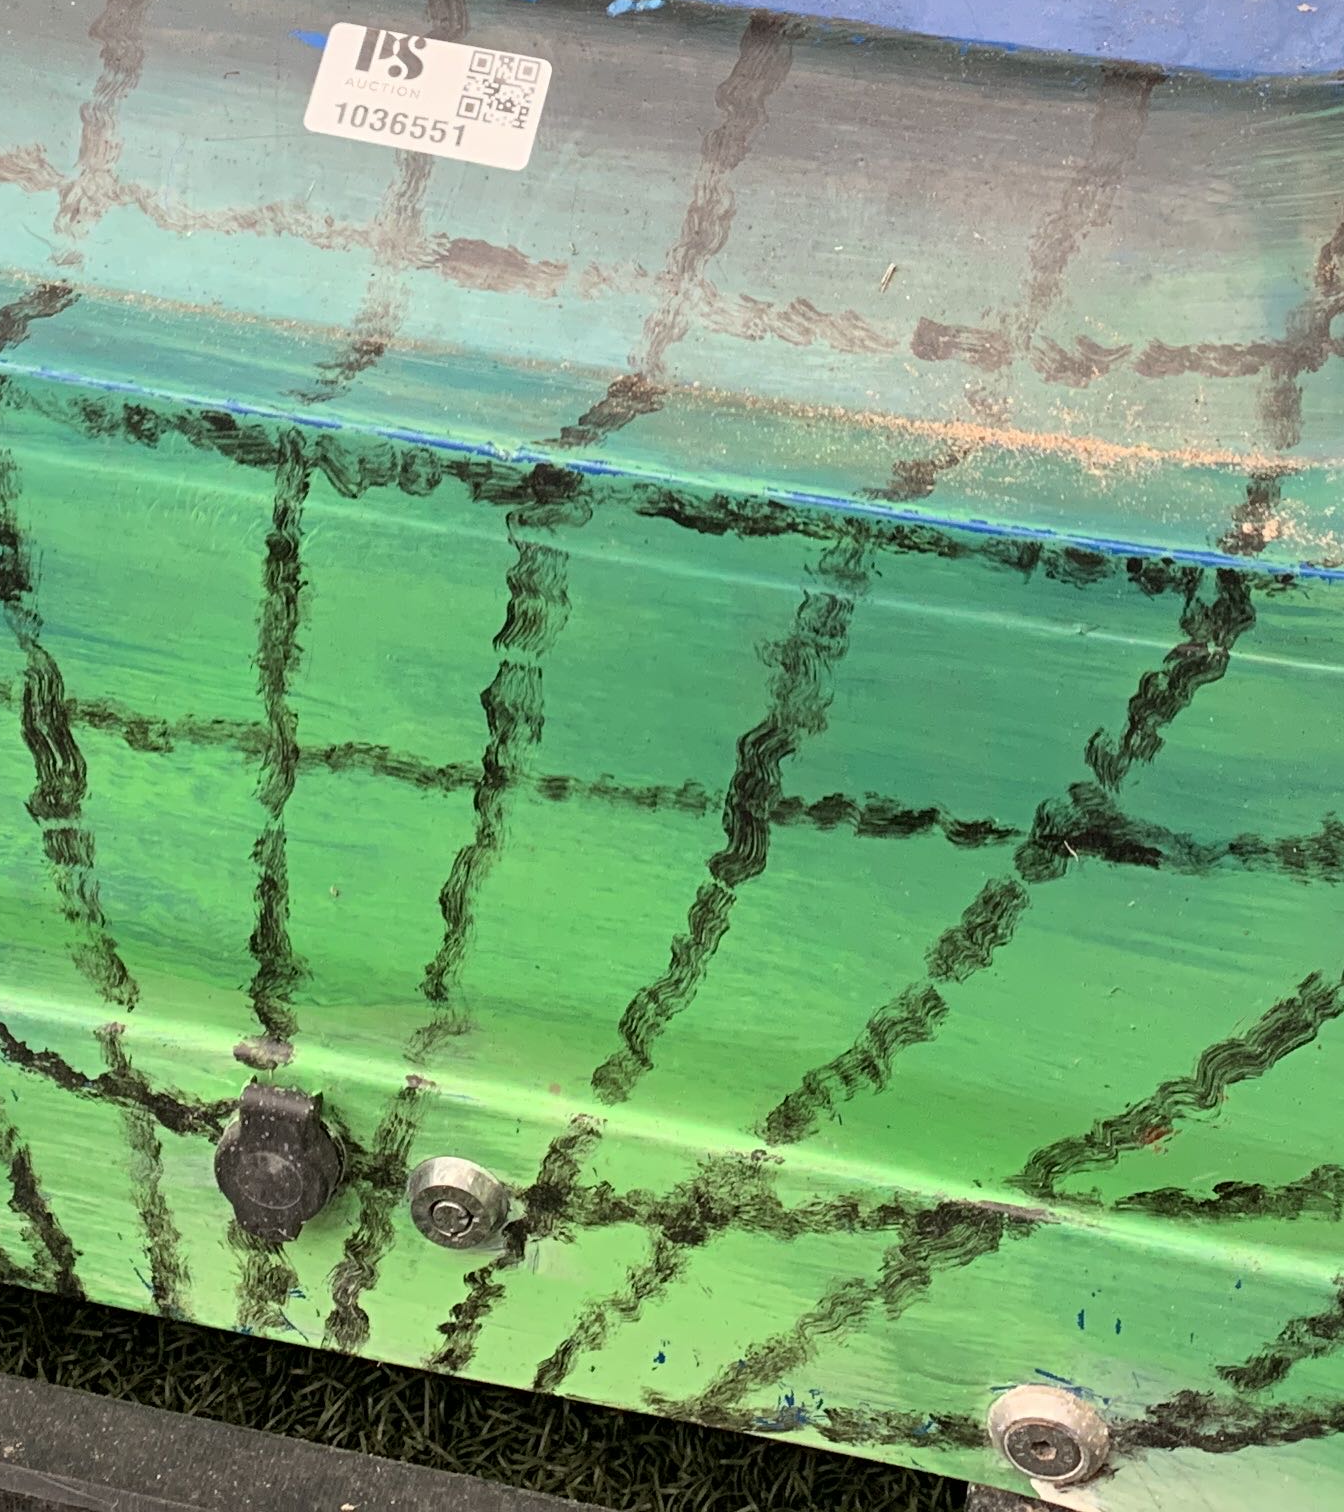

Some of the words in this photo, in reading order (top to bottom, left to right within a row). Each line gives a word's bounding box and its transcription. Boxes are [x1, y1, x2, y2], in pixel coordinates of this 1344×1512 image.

[355, 28, 426, 80] PS
[344, 77, 421, 99] AUCTION
[335, 102, 466, 146] 1036551
